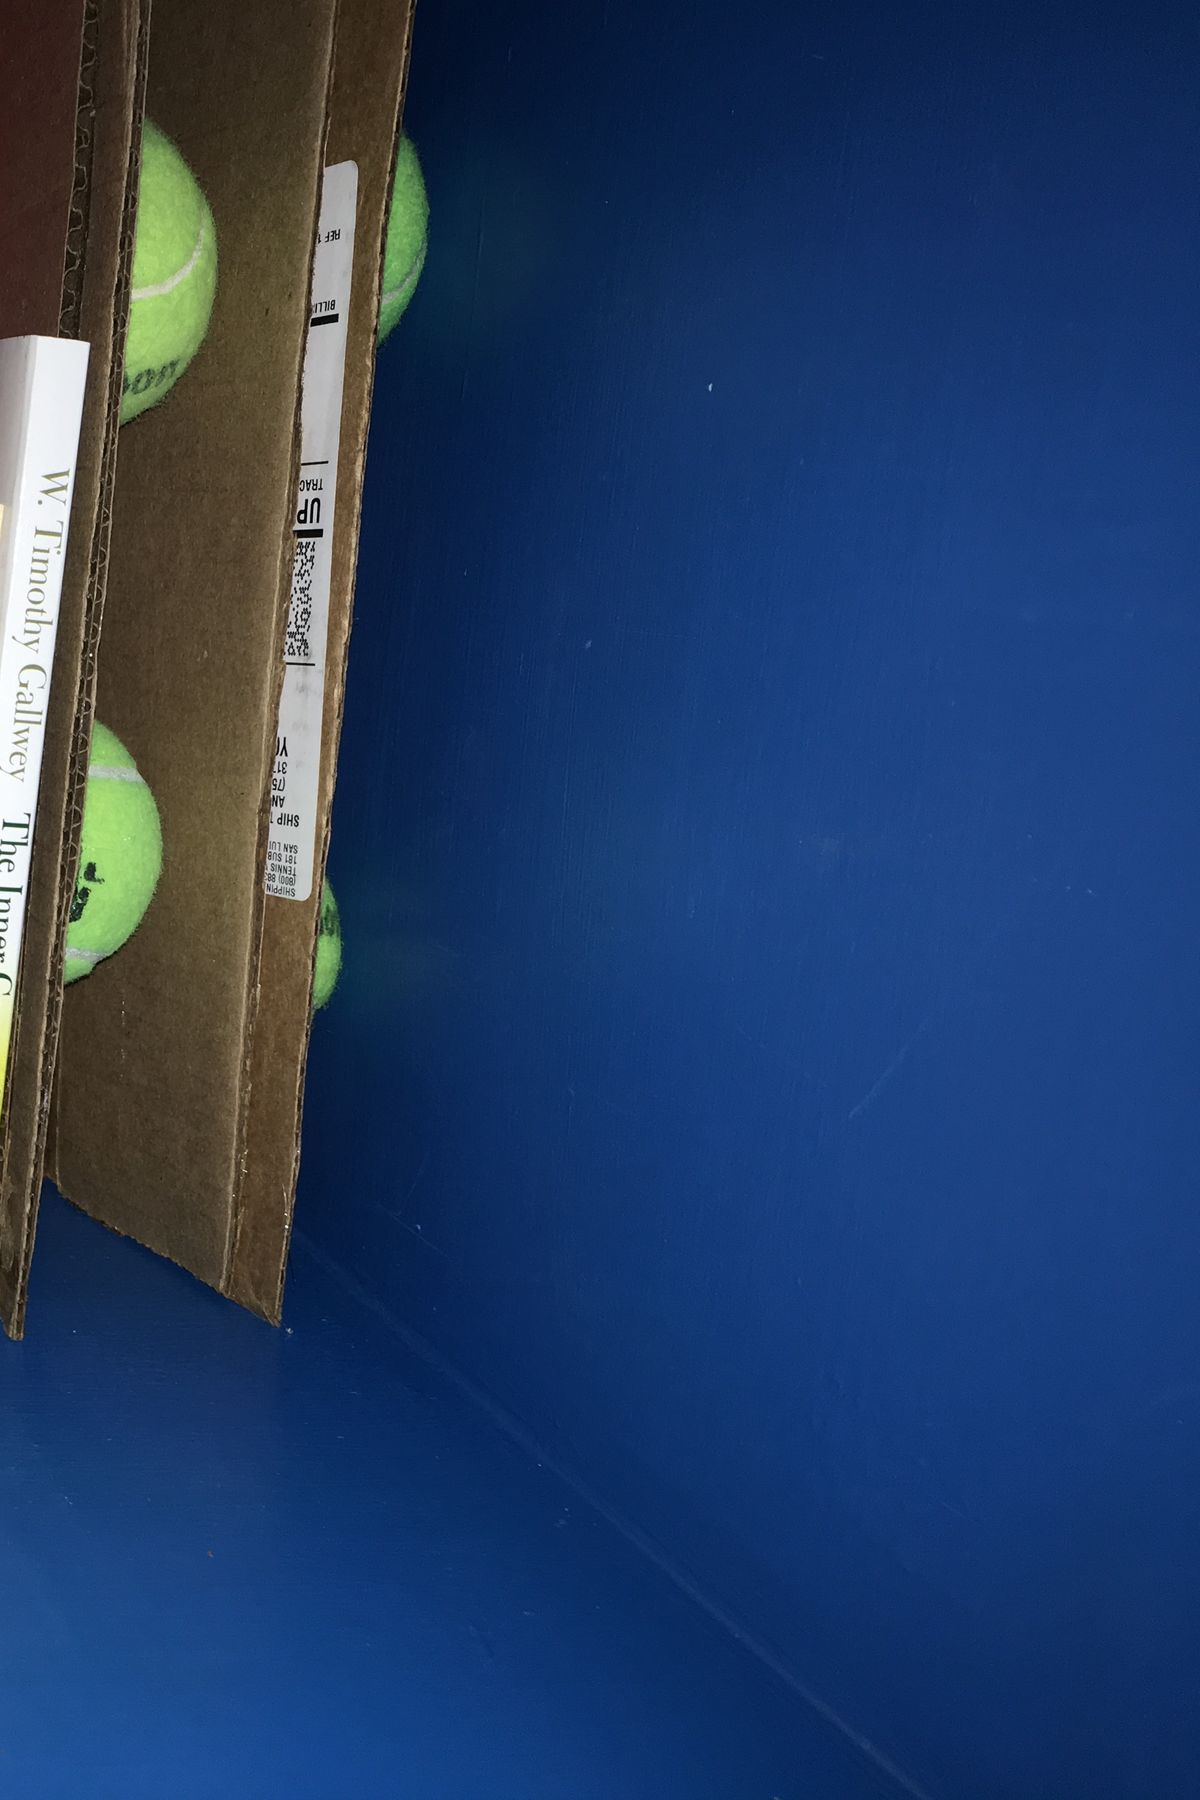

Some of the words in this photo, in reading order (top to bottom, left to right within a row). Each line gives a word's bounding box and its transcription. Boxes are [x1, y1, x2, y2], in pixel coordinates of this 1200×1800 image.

[325, 229, 341, 243] REF
[312, 300, 336, 313] BILLI
[37, 468, 70, 505] W.
[299, 478, 323, 492] TRAC
[297, 497, 321, 524] UP
[11, 520, 64, 654] Timothy
[277, 813, 300, 828] SHIP
[267, 850, 282, 862] SUB
[283, 844, 298, 854] SAN
[284, 854, 297, 865] 181
[270, 862, 296, 877] TENNIS
[279, 873, 296, 887] (800)
